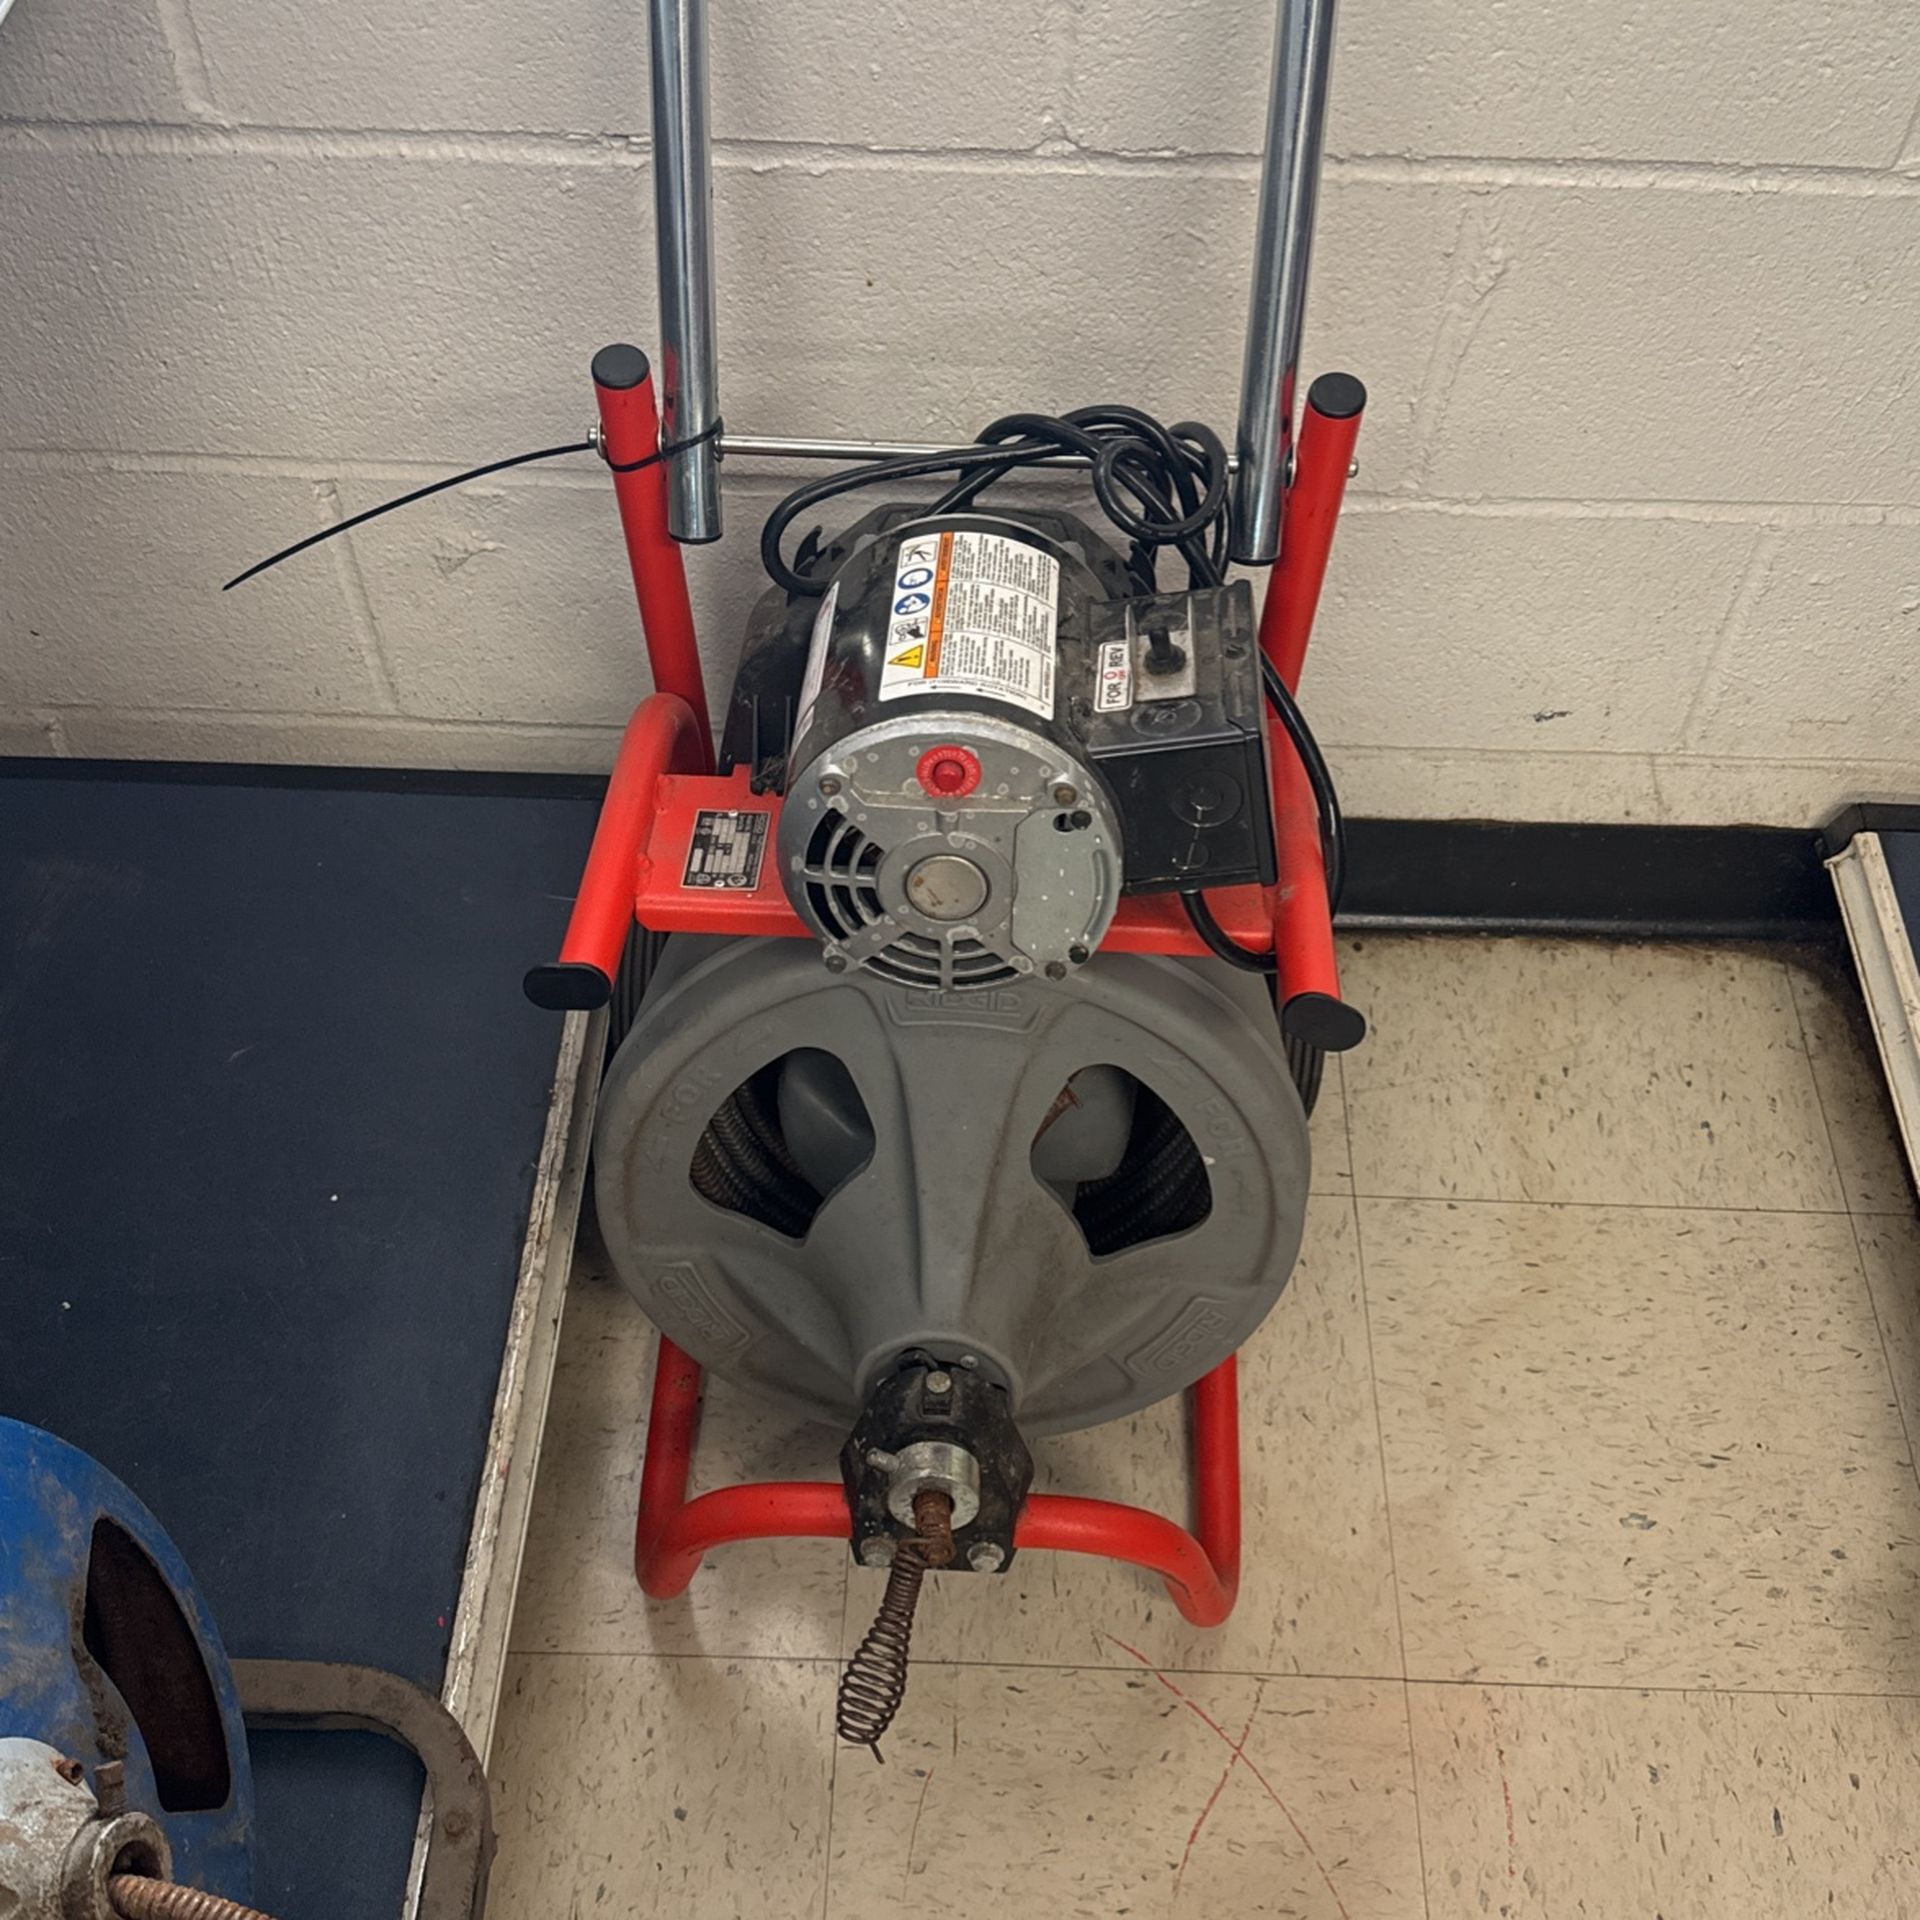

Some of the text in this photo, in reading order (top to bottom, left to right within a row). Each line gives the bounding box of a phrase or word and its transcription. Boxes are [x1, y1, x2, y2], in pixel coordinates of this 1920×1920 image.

[1109, 647, 1124, 667] REV
[1107, 682, 1123, 705] FOR
[906, 990, 1022, 1012] RIDGID
[658, 1275, 728, 1340] RIDGID
[1154, 1308, 1230, 1370] RIDGID
